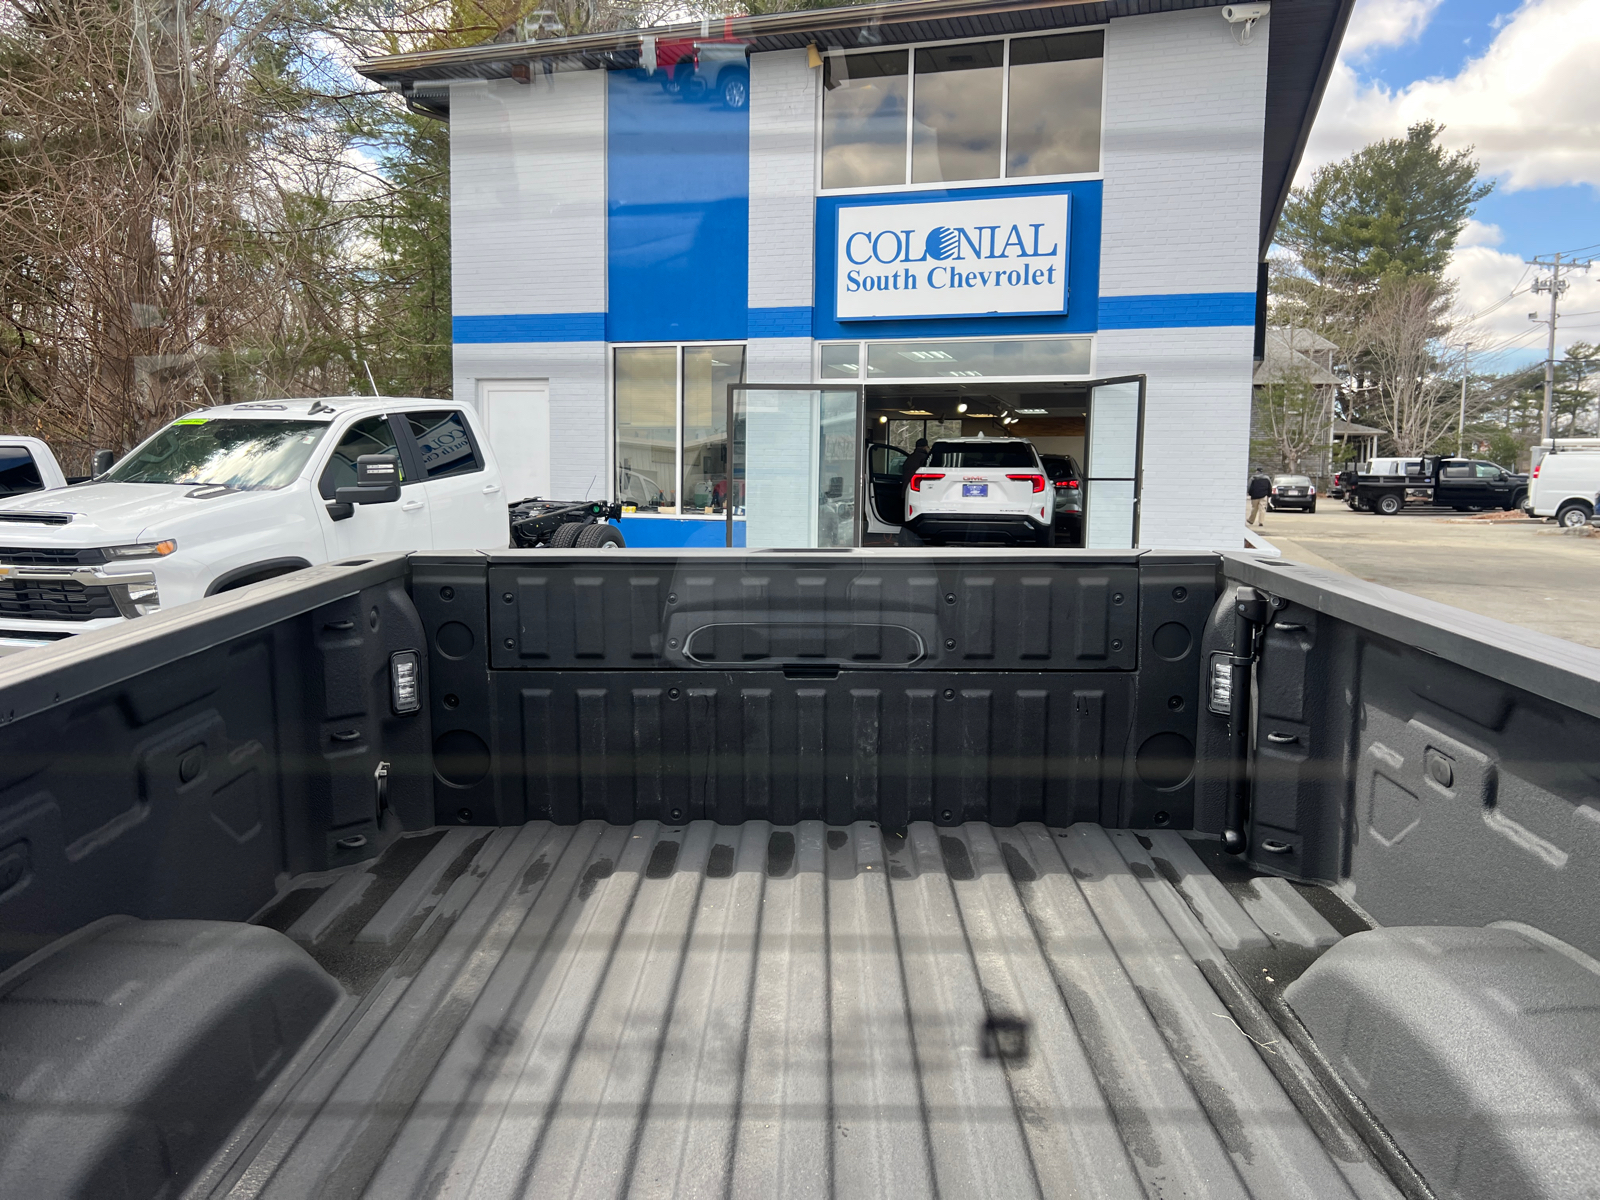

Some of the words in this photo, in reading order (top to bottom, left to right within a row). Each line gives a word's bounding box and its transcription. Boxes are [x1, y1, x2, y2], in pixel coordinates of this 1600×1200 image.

[845, 223, 1058, 265] COLONIAL
[846, 268, 918, 292] South
[927, 263, 1057, 289] Chevrolet
